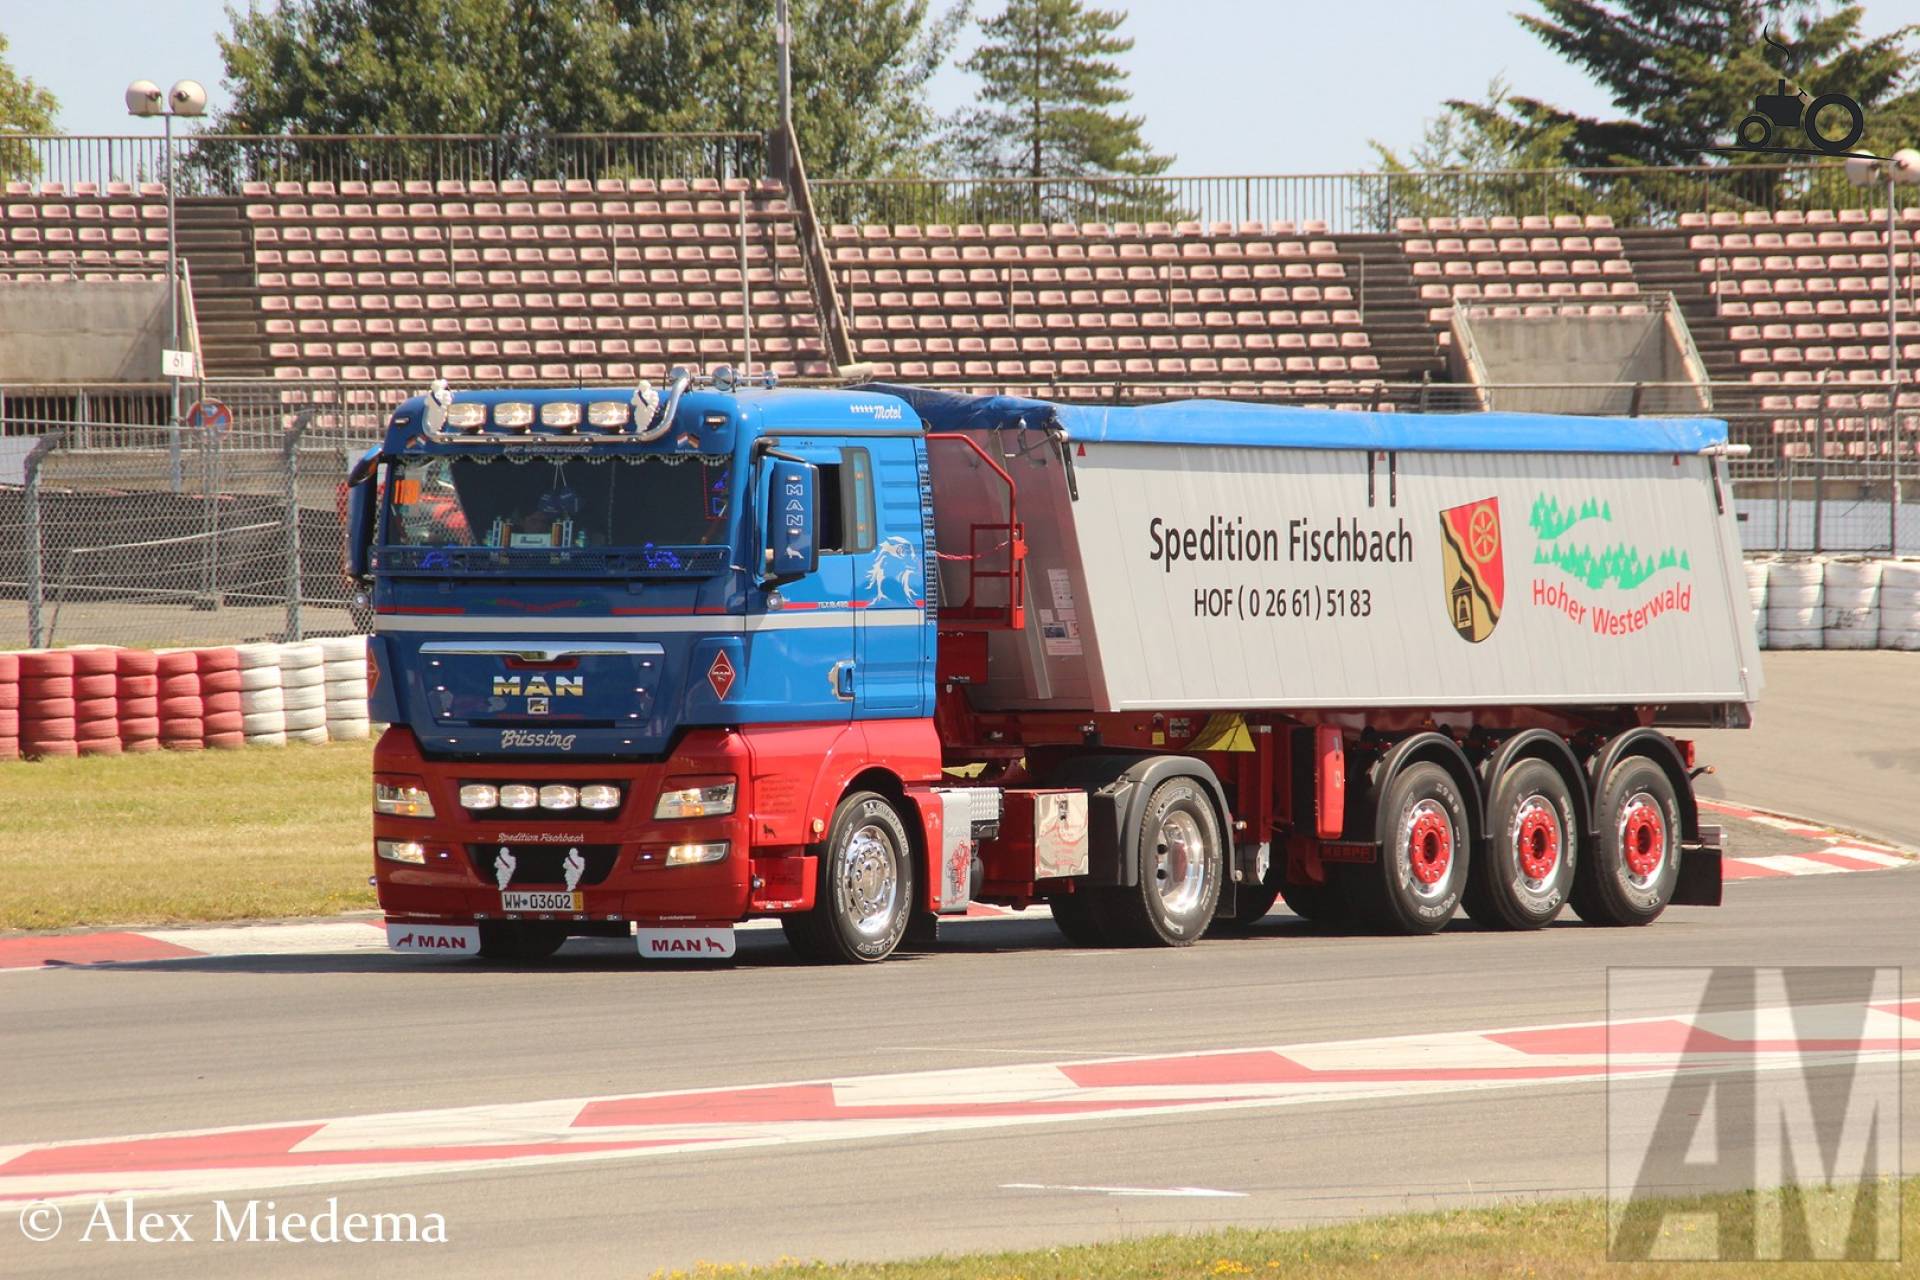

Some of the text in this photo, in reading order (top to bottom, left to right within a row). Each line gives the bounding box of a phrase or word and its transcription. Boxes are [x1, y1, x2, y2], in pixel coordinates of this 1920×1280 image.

[172, 353, 184, 368] 61
[785, 483, 805, 527] MAN
[1150, 515, 1413, 573] Spedition Fischbach
[1194, 588, 1233, 617] HOF
[1327, 588, 1371, 617] 5183
[1533, 579, 1692, 635] Hoher Westerwald
[493, 676, 584, 697] MAN
[501, 729, 577, 751] Büssing
[418, 935, 466, 949] MAN
[651, 939, 702, 952] MAN
